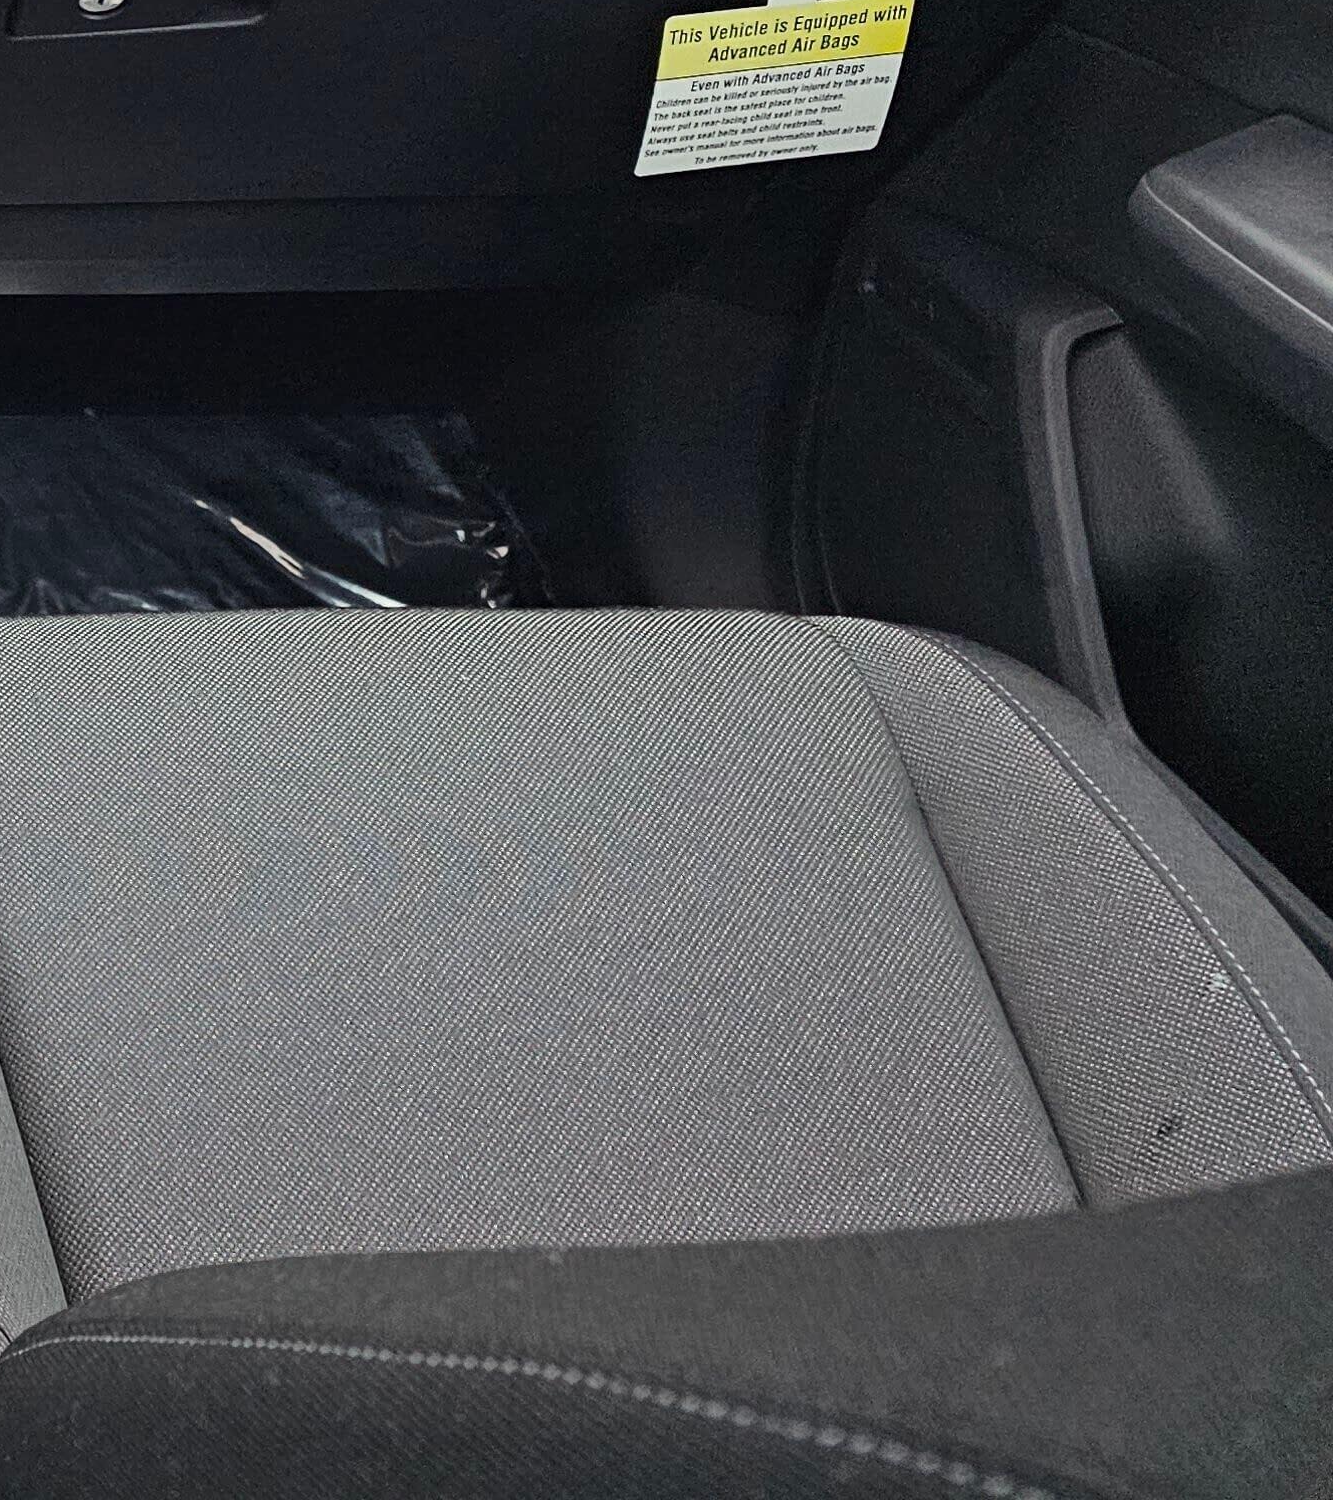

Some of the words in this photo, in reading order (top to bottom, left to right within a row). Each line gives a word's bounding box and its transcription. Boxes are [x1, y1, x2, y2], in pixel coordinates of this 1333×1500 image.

[670, 28, 702, 45] This
[709, 21, 768, 41] Vehicle
[774, 18, 788, 33] is
[794, 9, 868, 33] Equipped
[874, 4, 907, 22] with
[708, 40, 787, 62] Advanced
[791, 37, 815, 53] Air
[820, 34, 860, 50] Bags
[691, 80, 719, 92] Even
[723, 75, 749, 88] with
[752, 67, 811, 84] Advanced
[814, 65, 832, 78] Air
[835, 63, 865, 77] Bags
[656, 98, 691, 109] Children
[693, 97, 708, 105] can
[711, 94, 721, 103] be
[723, 91, 748, 102] killed
[760, 83, 798, 97] seriously
[800, 80, 830, 92] injured
[832, 77, 843, 90] by
[845, 77, 858, 87] the
[860, 76, 872, 85] air
[651, 124, 675, 133] Never
[677, 121, 691, 132] put
[750, 113, 771, 122] child
[773, 110, 793, 119] seat
[795, 108, 803, 117] in
[805, 107, 819, 115] the
[654, 112, 669, 122] The
[672, 109, 690, 119] back
[694, 107, 712, 116] seat
[724, 103, 738, 113] the
[740, 101, 767, 111] safest
[768, 98, 792, 110] place
[794, 97, 806, 105] for
[644, 149, 660, 157] See
[817, 128, 840, 138] about
[841, 125, 854, 134] air
[647, 135, 677, 146] Always
[680, 134, 694, 142] use
[697, 131, 716, 140] seat
[759, 123, 780, 133] child
